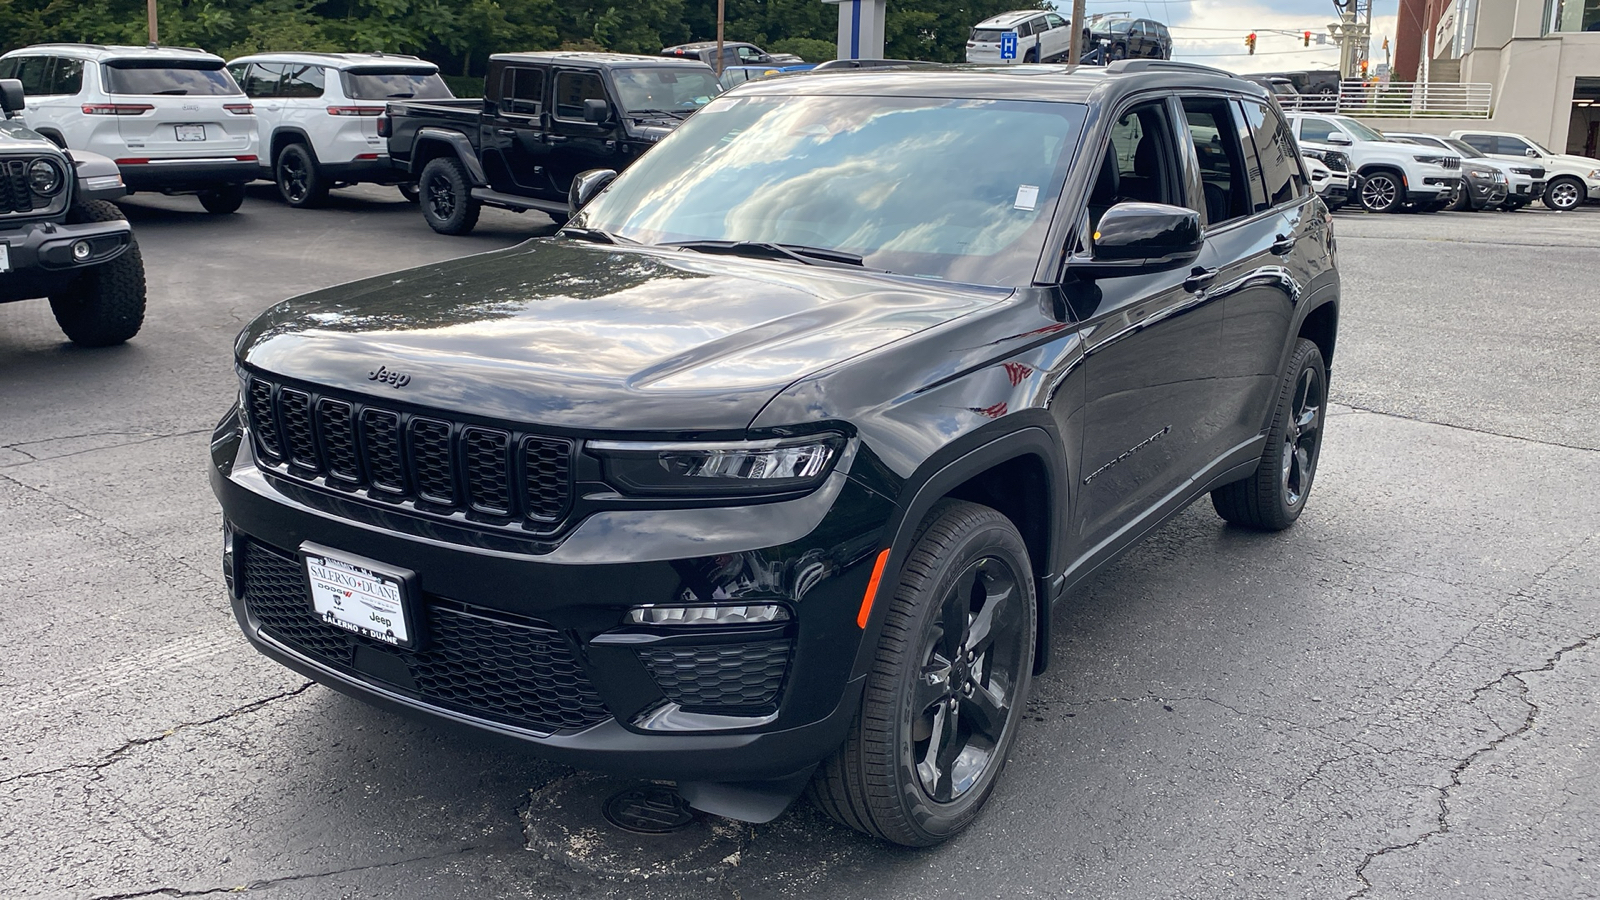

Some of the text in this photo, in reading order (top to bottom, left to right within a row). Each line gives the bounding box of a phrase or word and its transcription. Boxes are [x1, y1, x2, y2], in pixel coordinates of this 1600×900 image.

[1004, 38, 1014, 52] H
[367, 365, 411, 389] Jeep
[310, 566, 399, 602] SALERNO DUANE
[322, 614, 398, 645] SALERNO DUANE
[369, 612, 392, 628] Jeep
